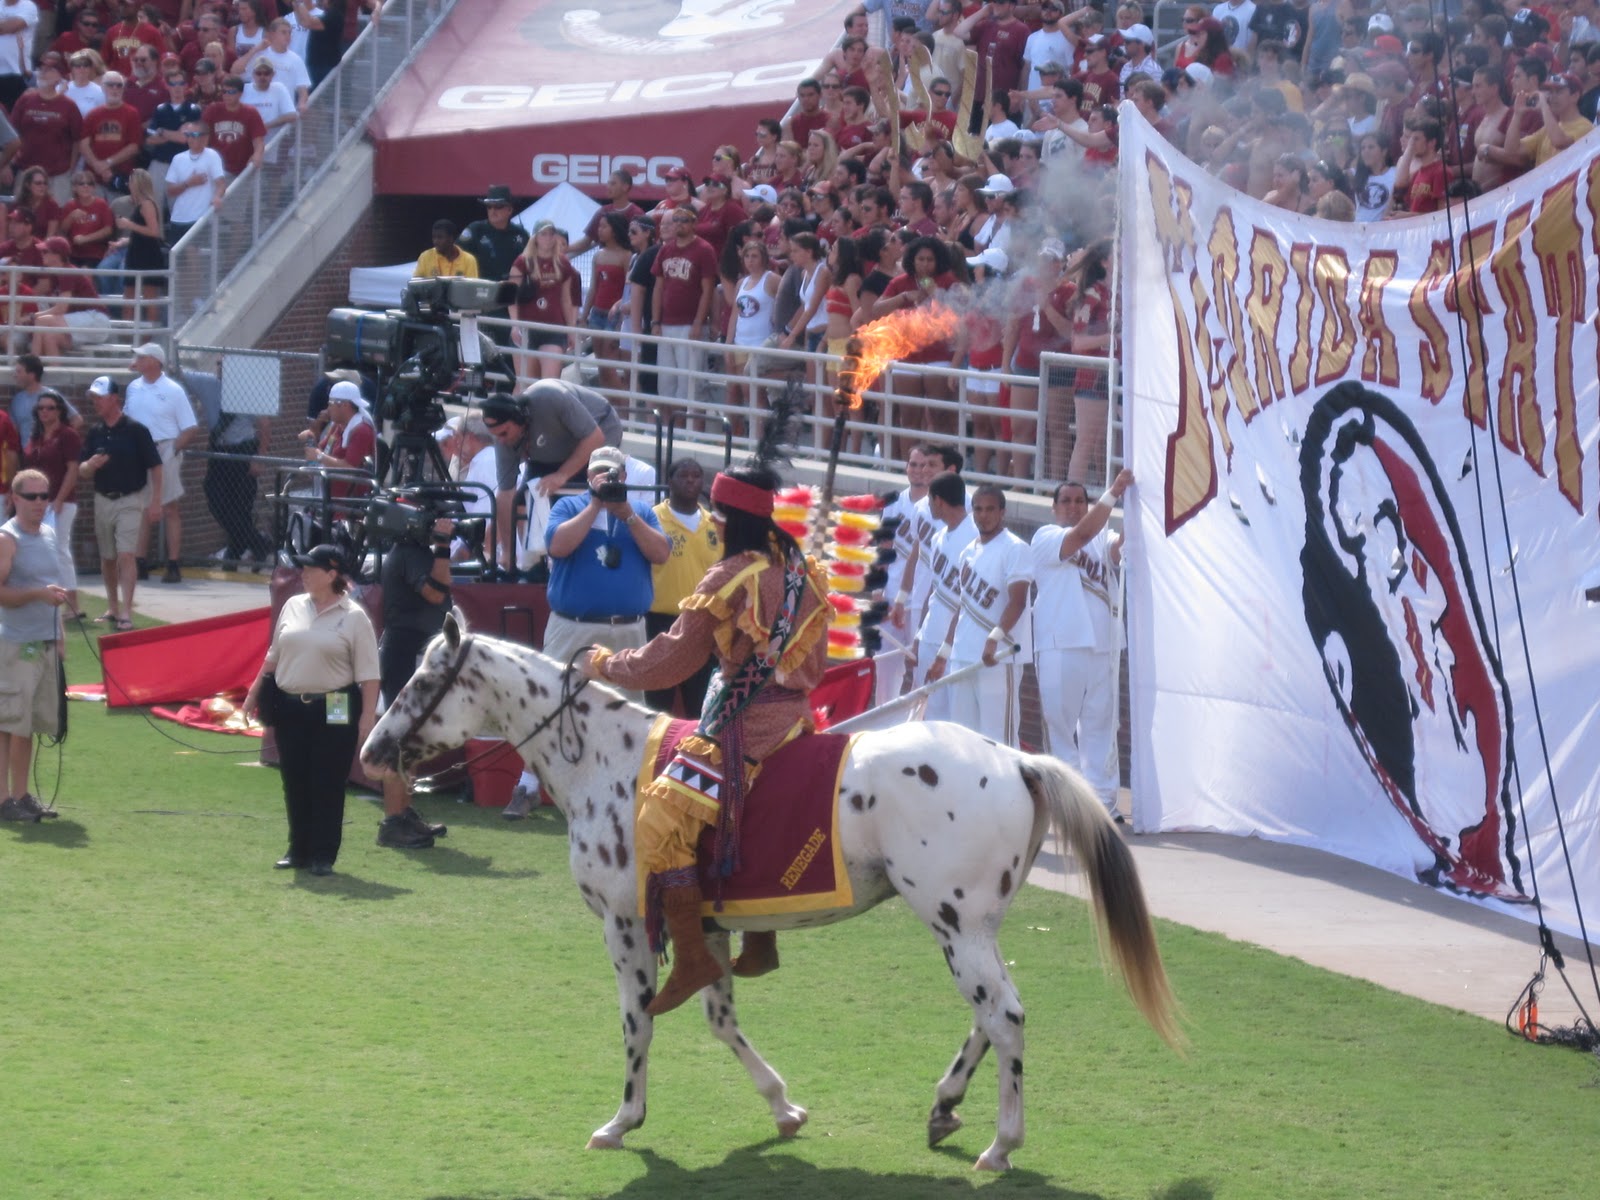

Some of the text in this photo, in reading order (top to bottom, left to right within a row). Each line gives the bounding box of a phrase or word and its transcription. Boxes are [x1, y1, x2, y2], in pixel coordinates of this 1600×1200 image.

[437, 58, 825, 110] GEICO
[532, 153, 685, 185] GEICO
[1408, 154, 1600, 520] STAT
[779, 828, 827, 891] RENEGADE
